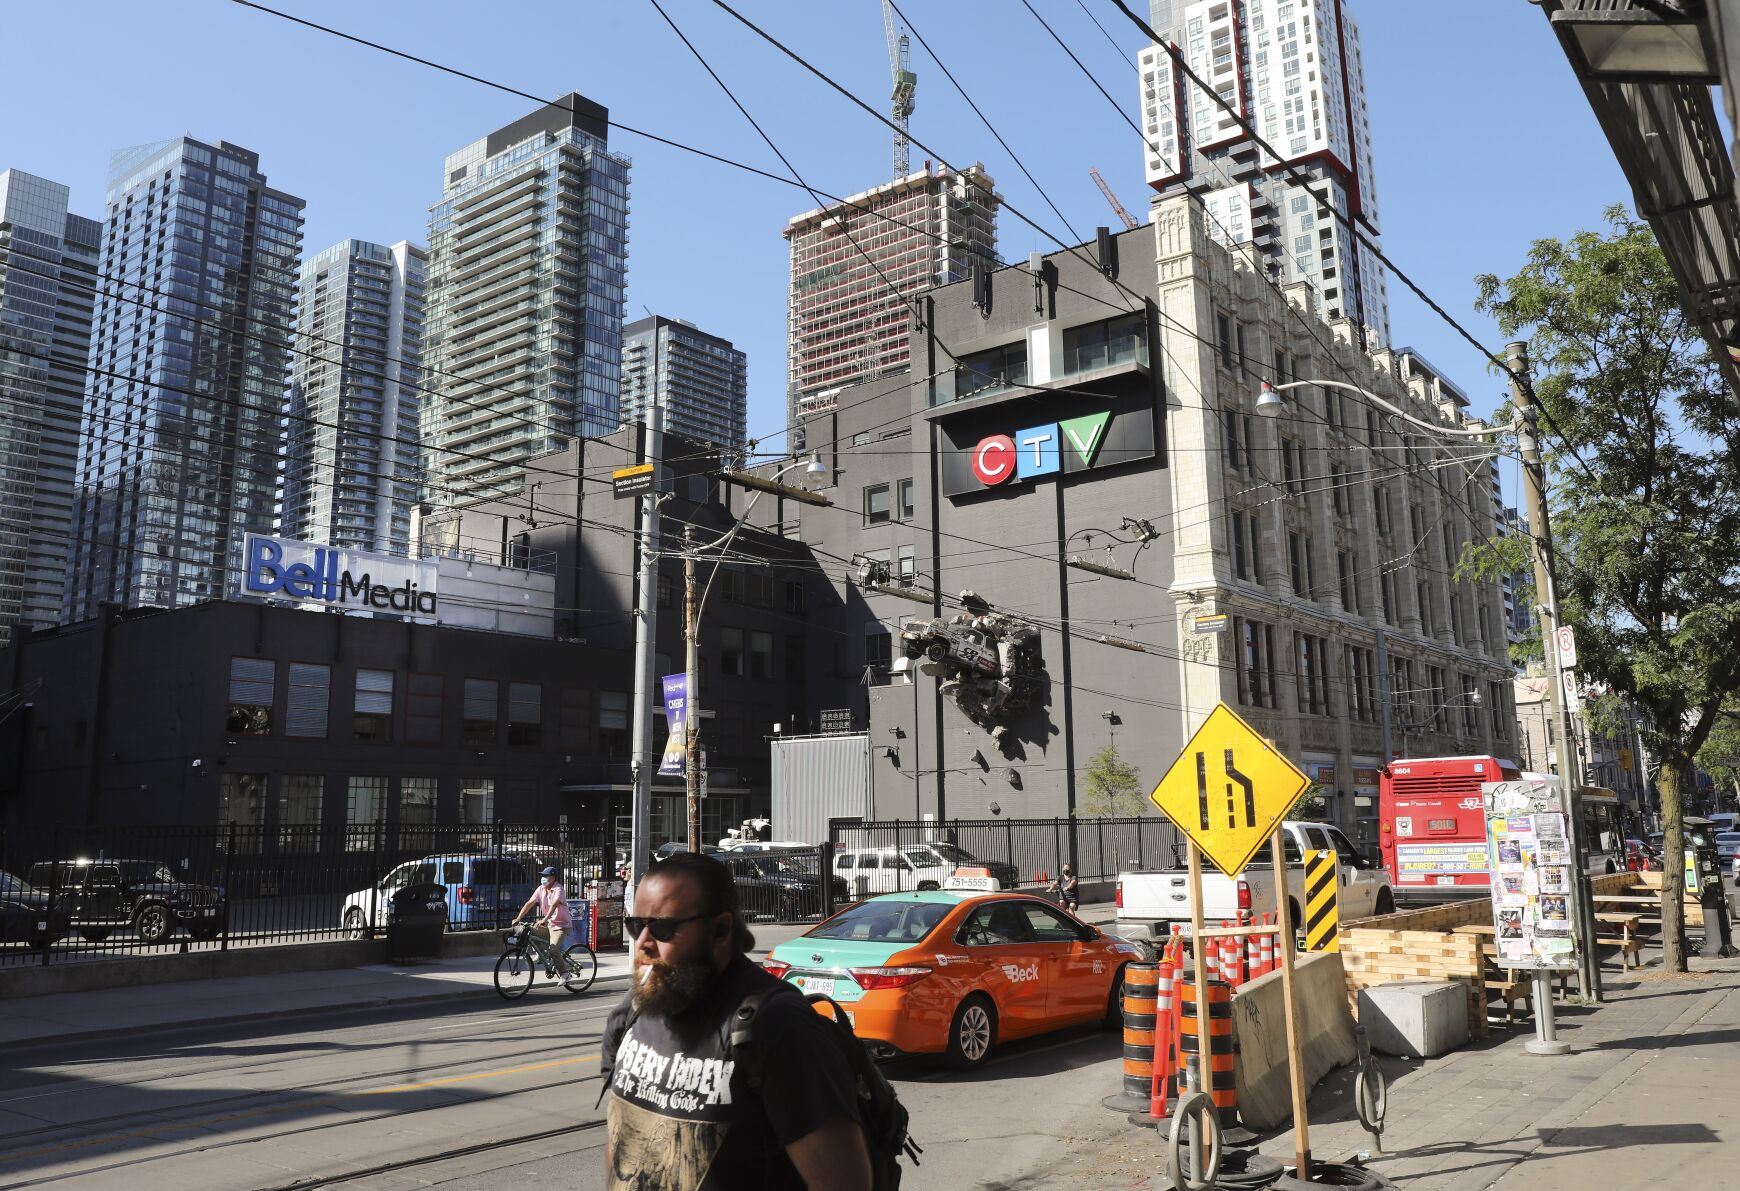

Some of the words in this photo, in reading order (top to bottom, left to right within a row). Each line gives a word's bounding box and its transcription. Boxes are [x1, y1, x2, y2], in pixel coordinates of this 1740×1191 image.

[978, 423, 1102, 477] CTV
[248, 537, 339, 600] Bell
[340, 570, 436, 614] Media
[952, 877, 988, 887] 751-5555
[1008, 964, 1039, 982] Beck
[615, 1069, 636, 1096] The
[635, 1079, 669, 1109] Killing
[666, 1052, 735, 1105] INDEX
